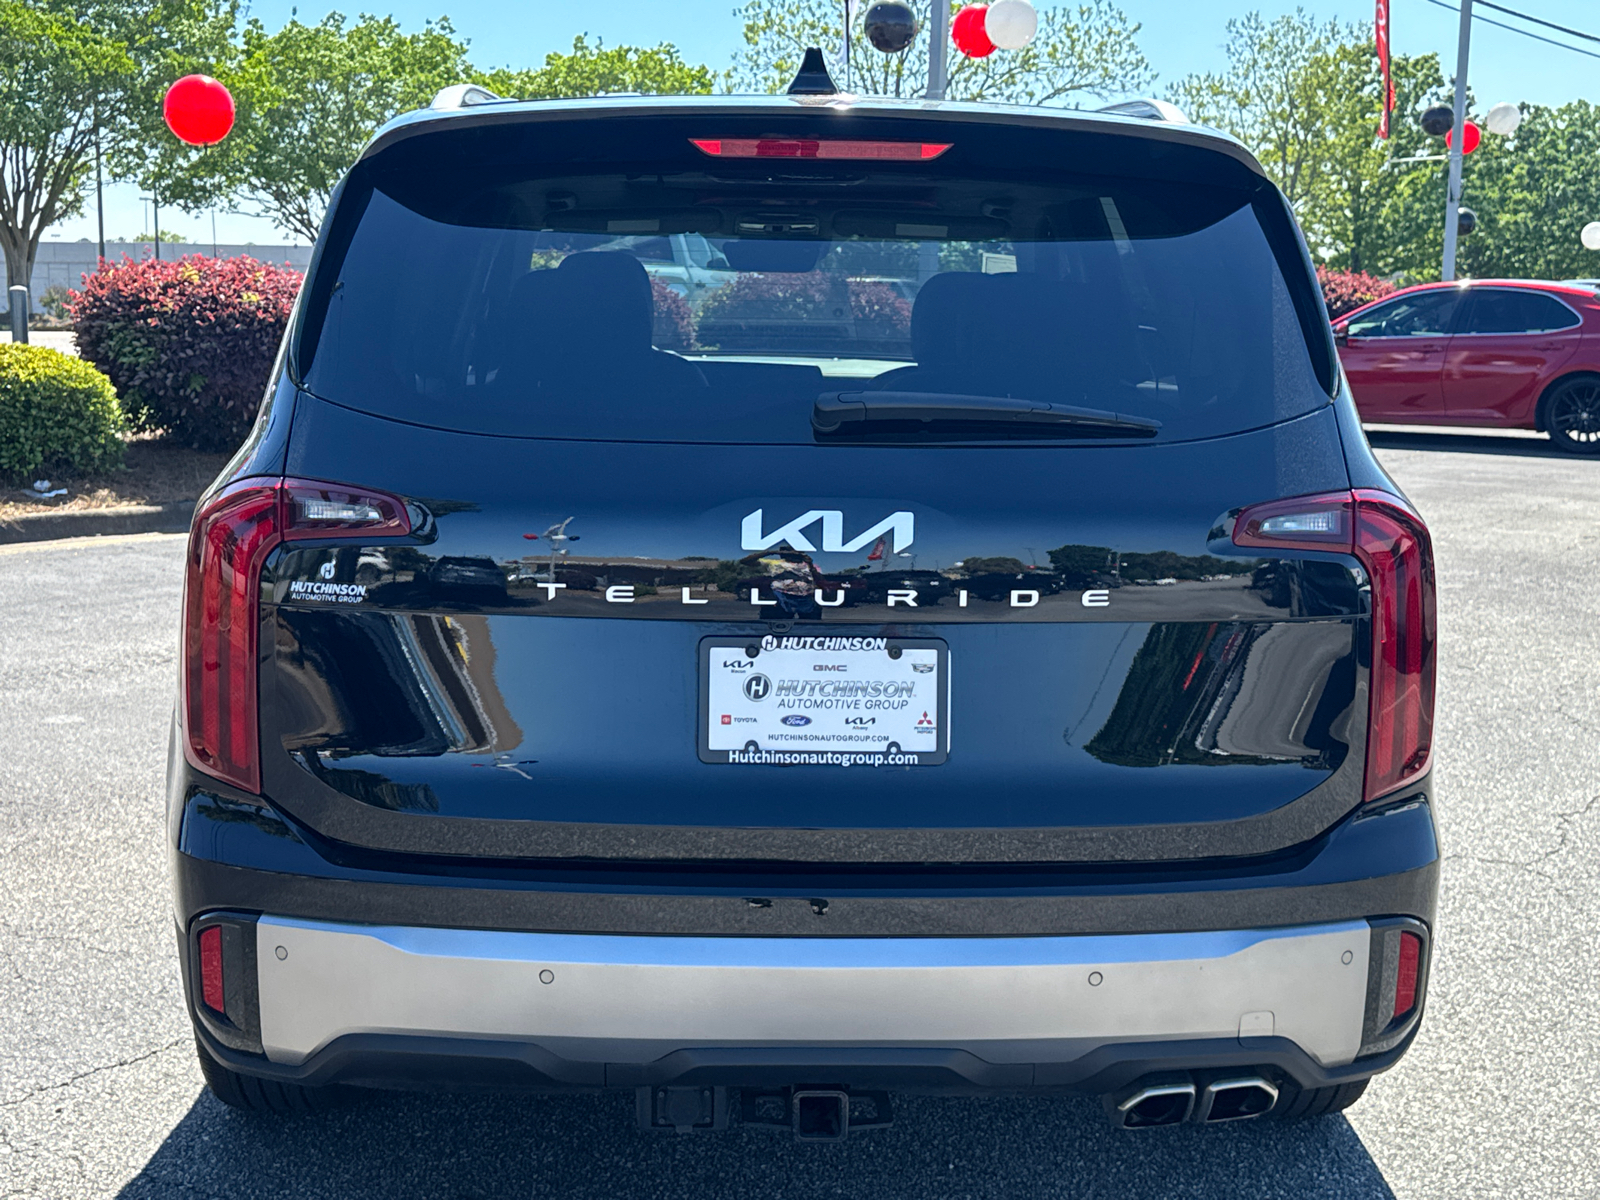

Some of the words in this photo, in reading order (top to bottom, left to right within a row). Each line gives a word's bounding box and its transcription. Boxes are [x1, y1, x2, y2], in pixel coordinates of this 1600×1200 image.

[741, 508, 915, 553] KIA
[290, 581, 367, 596] HUTCHINSON
[537, 581, 1111, 608] TELLURIDE
[291, 592, 337, 602] AUTOMOTIVE
[338, 595, 363, 604] GROUP
[780, 636, 887, 651] HUTCHINSON
[723, 660, 754, 668] KIA
[813, 664, 847, 672] GMC
[775, 680, 916, 698] HUTCHINSON
[777, 698, 861, 709] AUTOMOTIVE
[864, 699, 909, 710] GROUP
[845, 716, 876, 725] KIA
[768, 733, 890, 742] HUTCHINSONAUTOGROUP.COM
[728, 750, 919, 767] Hutchinsonautogroup.com
